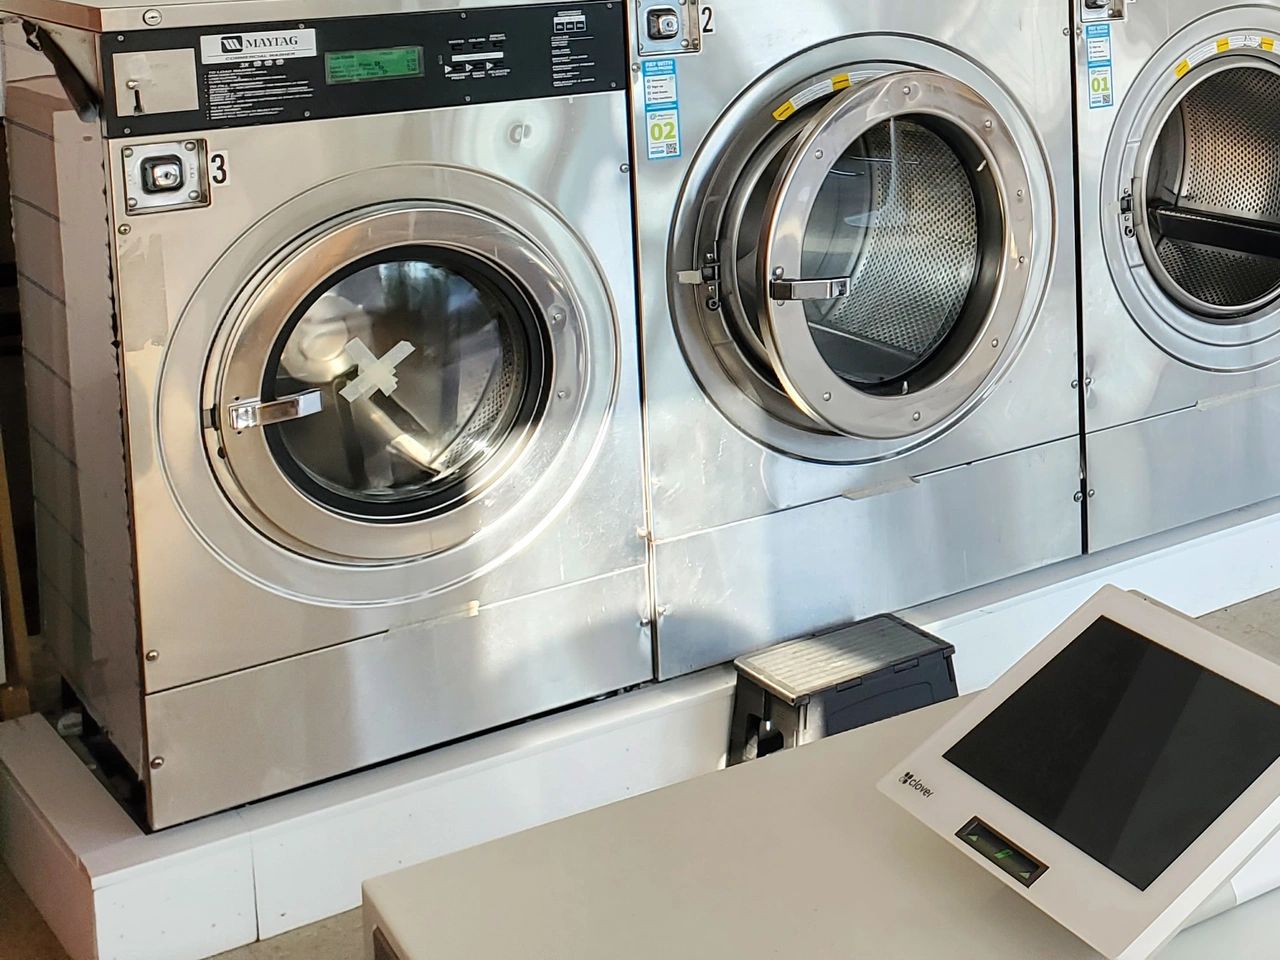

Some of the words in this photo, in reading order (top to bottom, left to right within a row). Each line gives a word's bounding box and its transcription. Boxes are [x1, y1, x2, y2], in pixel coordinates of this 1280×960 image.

[701, 6, 714, 33] 2
[245, 35, 298, 49] MAYTAG
[1091, 76, 1110, 93] 01
[650, 121, 676, 141] 02
[210, 153, 227, 184] 3
[908, 778, 934, 798] clover
